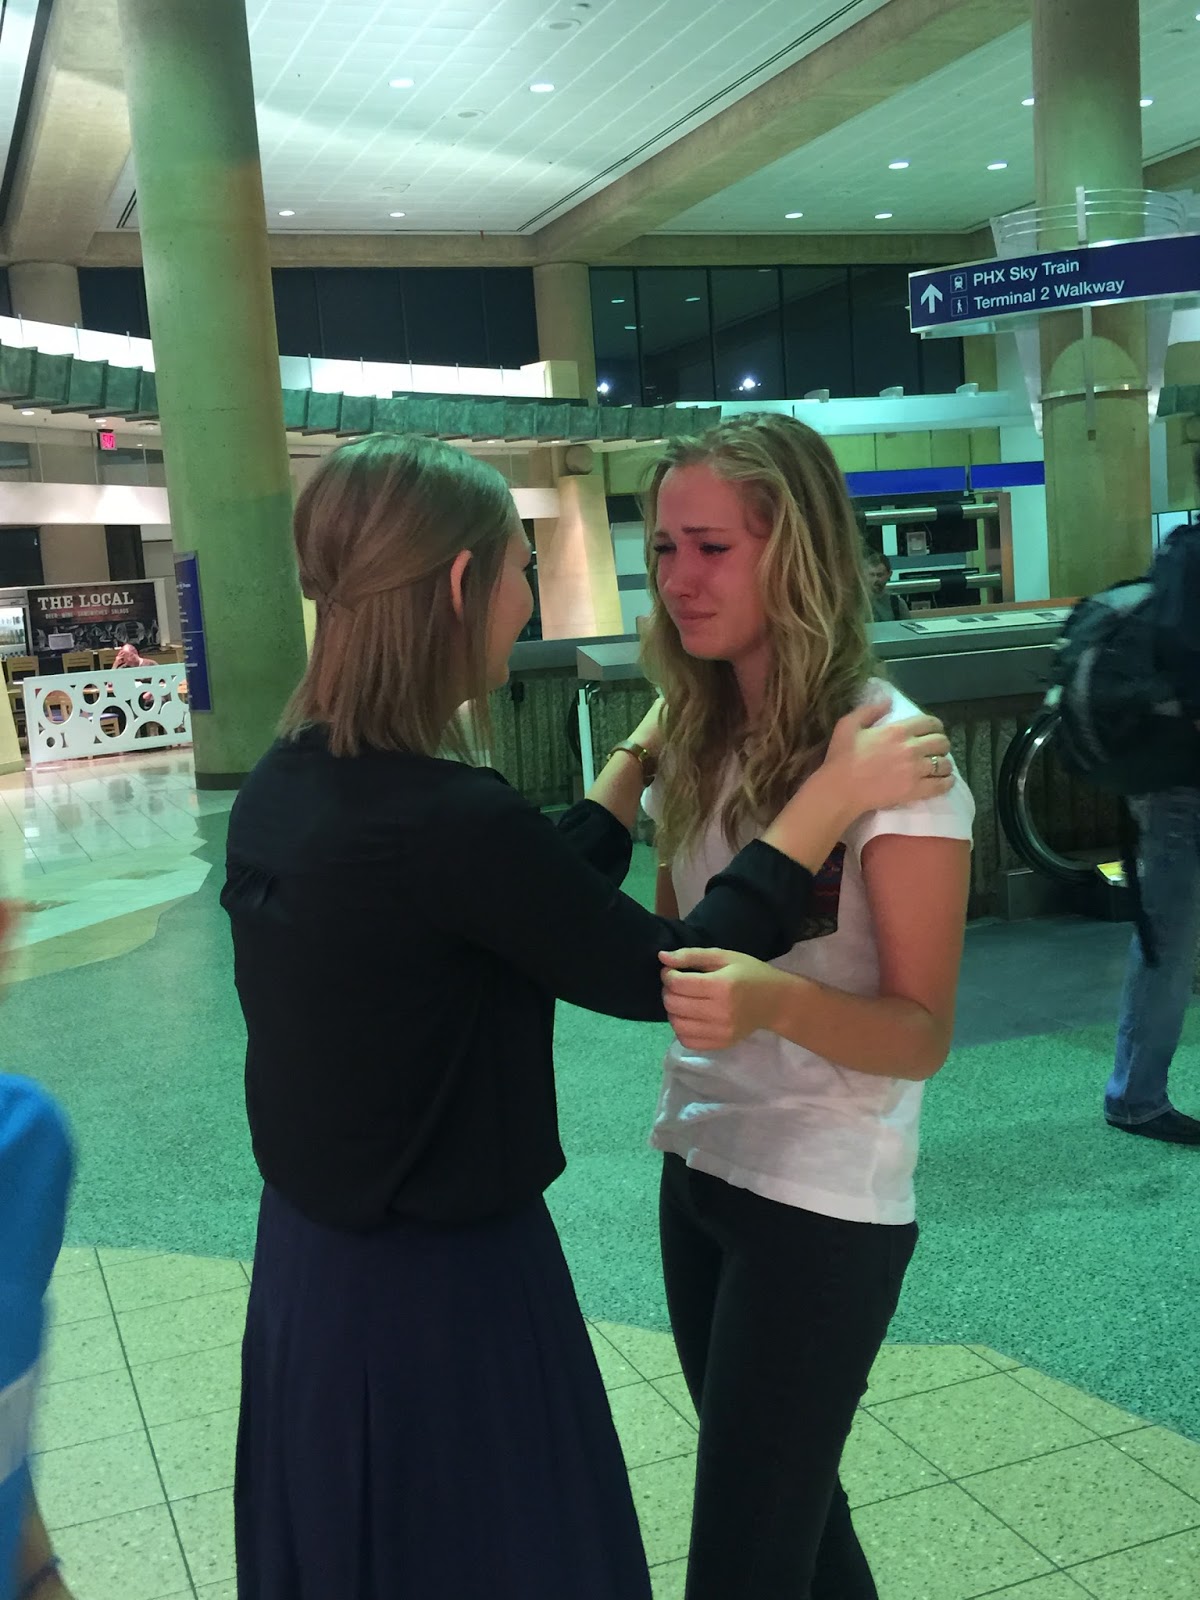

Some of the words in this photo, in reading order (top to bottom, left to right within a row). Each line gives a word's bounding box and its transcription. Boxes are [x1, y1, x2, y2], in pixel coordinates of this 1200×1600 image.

[973, 268, 1006, 287] PHX
[1009, 266, 1038, 282] Sky
[1041, 259, 1080, 276] Train
[973, 288, 1036, 310] Terminal
[1040, 286, 1050, 301] 2
[1053, 279, 1125, 299] Walkway
[37, 595, 74, 611] THE
[78, 591, 134, 608] LOCAL
